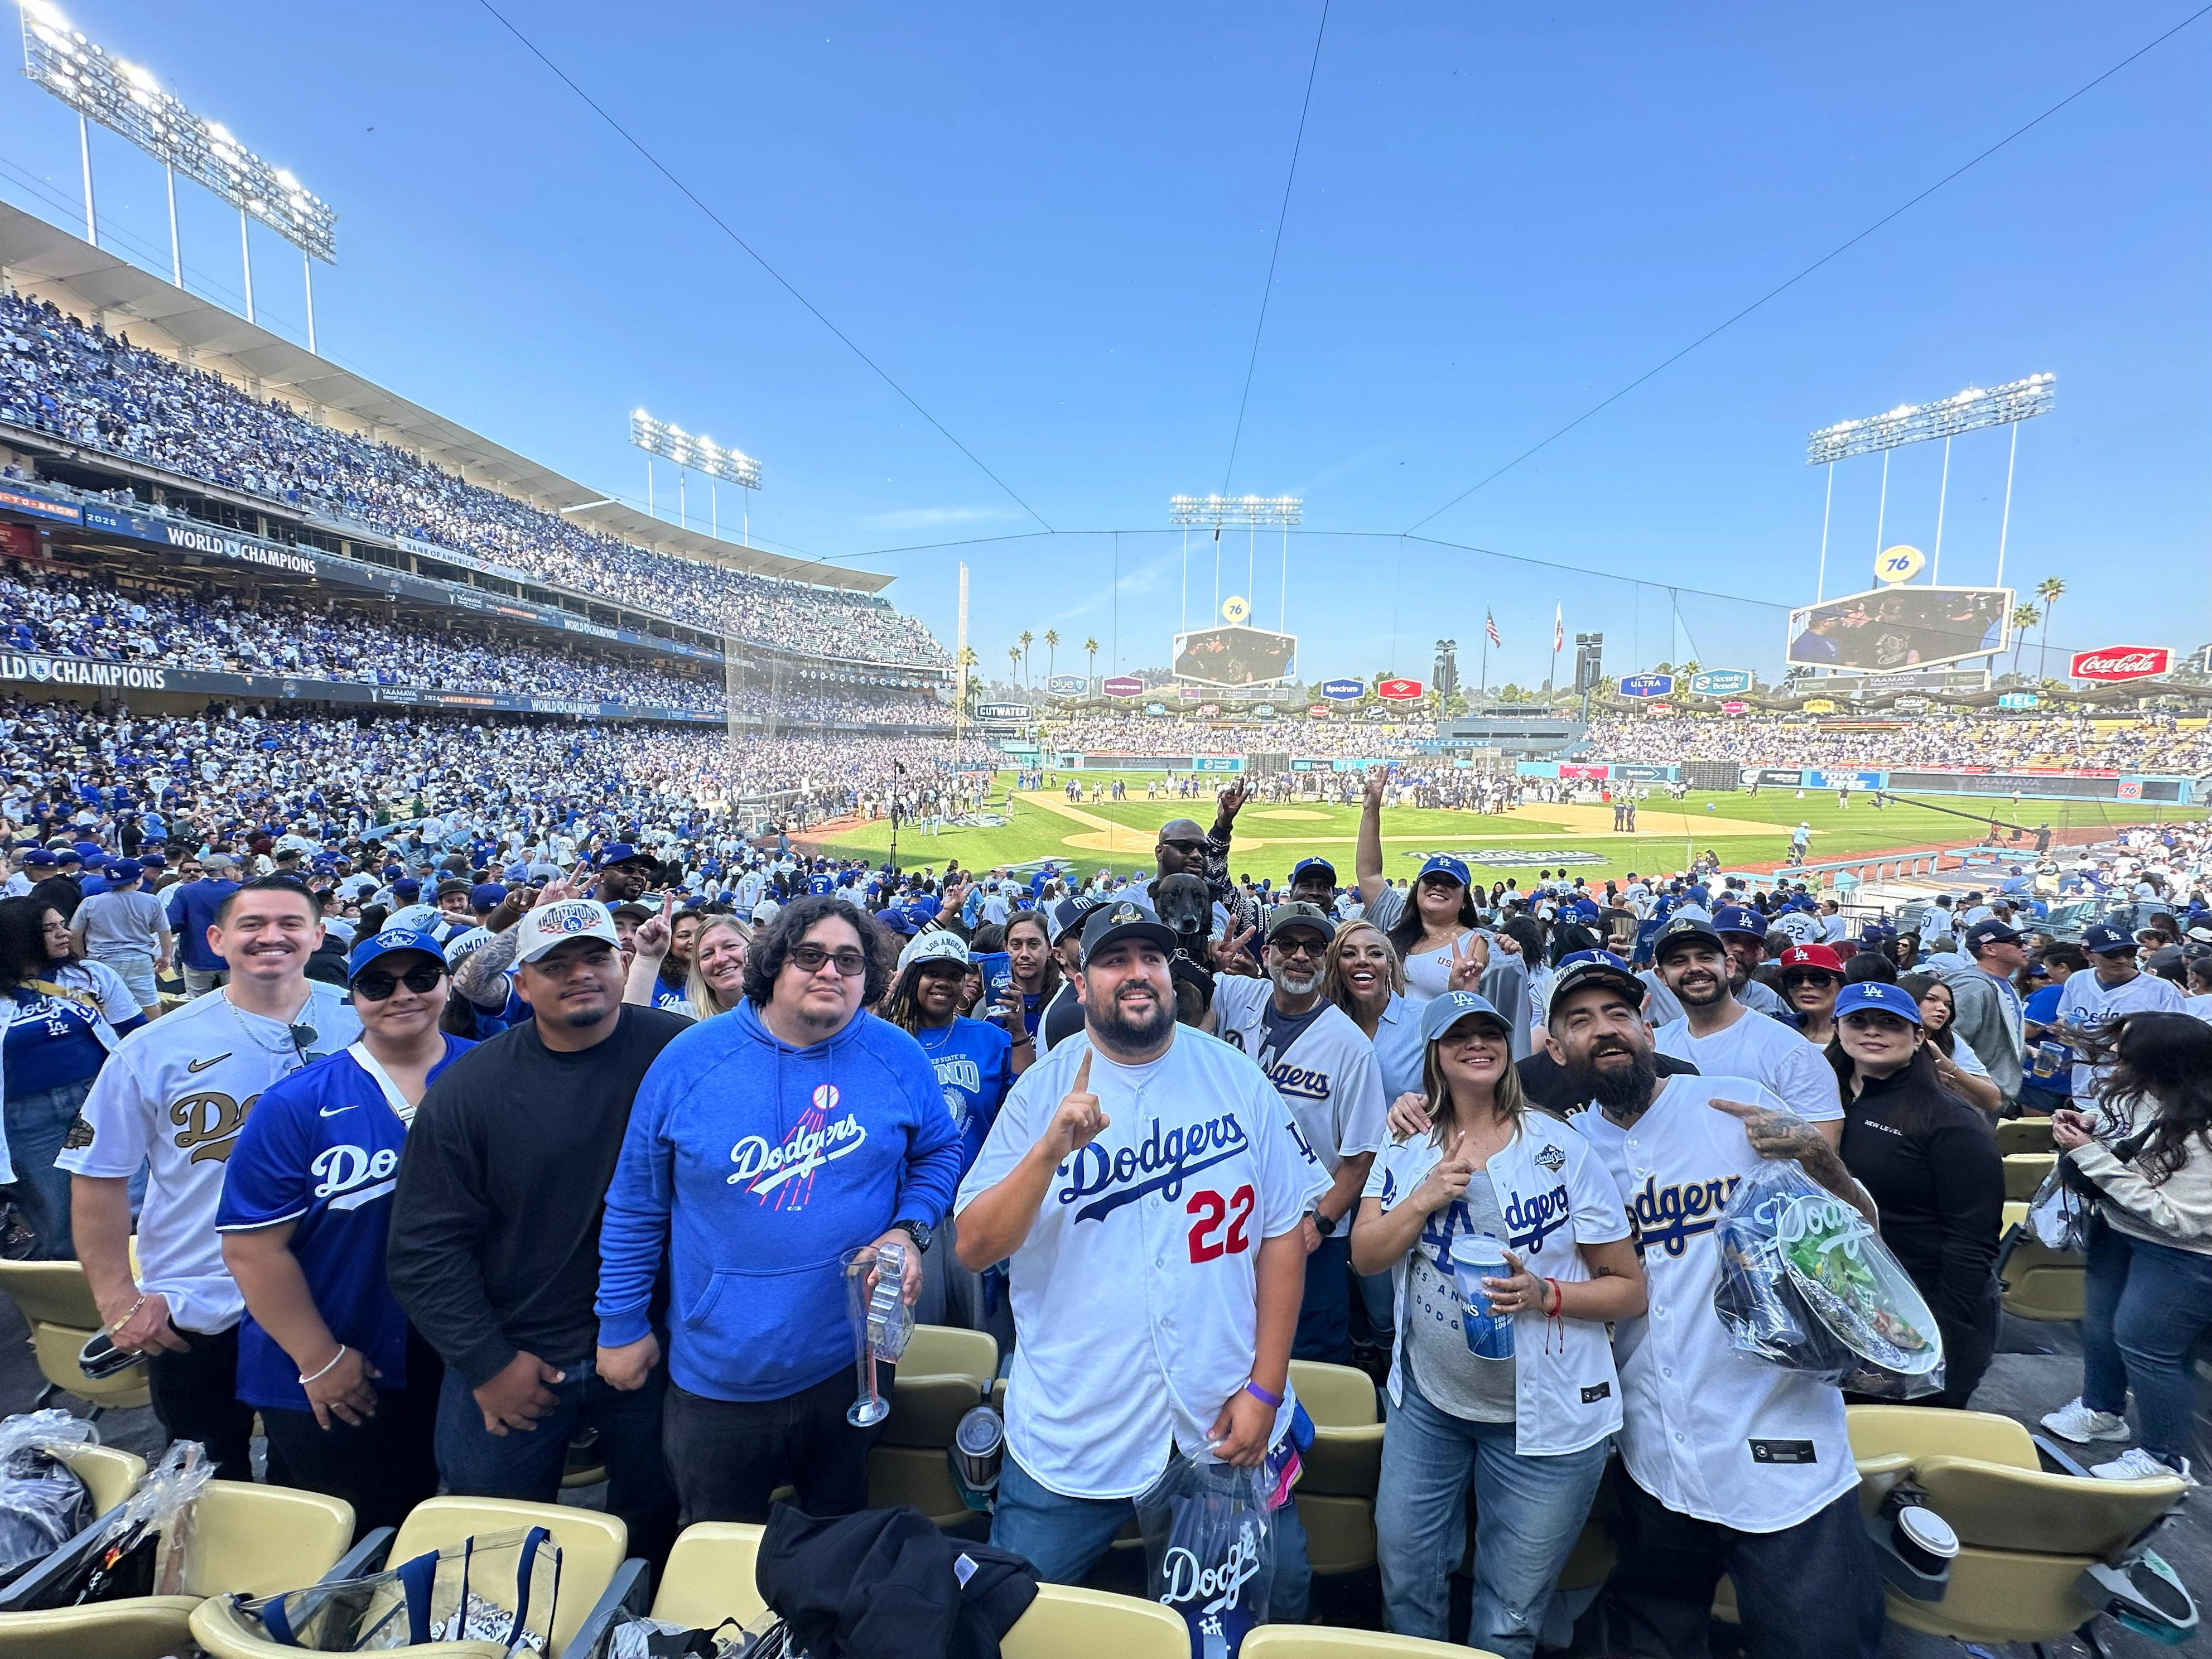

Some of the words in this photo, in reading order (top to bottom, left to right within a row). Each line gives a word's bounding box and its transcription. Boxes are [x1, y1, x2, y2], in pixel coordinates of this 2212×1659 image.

[86, 513, 117, 527] 2025
[167, 527, 224, 554] WORLD
[240, 544, 316, 575] CHAMPIONS
[407, 543, 428, 556] BANK
[442, 553, 474, 568] AMERICA
[1886, 555, 1910, 572] 76
[1230, 604, 1242, 615] 76
[564, 619, 584, 632] WORLD
[589, 624, 618, 639] CHAMPIONS
[2078, 653, 2160, 674] Coca-Cola
[0, 654, 27, 679] LD
[52, 660, 165, 689] CHAMPIONS
[1713, 674, 1744, 683] Security
[1051, 679, 1074, 689] blue
[1326, 685, 1358, 693] Spectrum
[381, 688, 417, 697] YAAMAVA
[531, 699, 556, 712] WORLD
[564, 701, 601, 715] CHAMPIONS
[980, 707, 1028, 717] CUTWATER
[1974, 777, 2040, 786] YAAMAVA
[2123, 785, 2137, 794] 76
[1438, 857, 1451, 867] LA
[110, 869, 122, 878] LA
[745, 882, 751, 893] 5
[816, 882, 823, 893] 2
[1005, 889, 1012, 898] 18
[1297, 904, 1312, 916] LA
[567, 918, 579, 930] LA
[1565, 914, 1577, 924] 50
[1739, 912, 1753, 928] LA
[1786, 918, 1810, 927] KERSHAW
[1922, 915, 1932, 928] 50
[1787, 925, 1805, 940] 22
[2104, 929, 2122, 941] LA
[925, 941, 939, 952] LOS
[941, 938, 966, 959] ANGELES
[1794, 947, 1810, 961] LA
[1437, 957, 1453, 968] US
[1591, 950, 1611, 966] LA
[1863, 983, 1884, 998] LA
[1450, 991, 1475, 1007] LA
[45, 1019, 70, 1036] LA
[941, 1054, 959, 1064] STATE
[934, 1060, 980, 1094] ND
[1266, 1062, 1330, 1099] gers
[1864, 1120, 1880, 1128] NEW
[1880, 1124, 1903, 1136] LEVEL
[726, 1113, 867, 1193] Dodgers
[1058, 1112, 1248, 1217] Dodgers
[1187, 1184, 1255, 1264] 22
[1416, 1294, 1459, 1331] DODG
